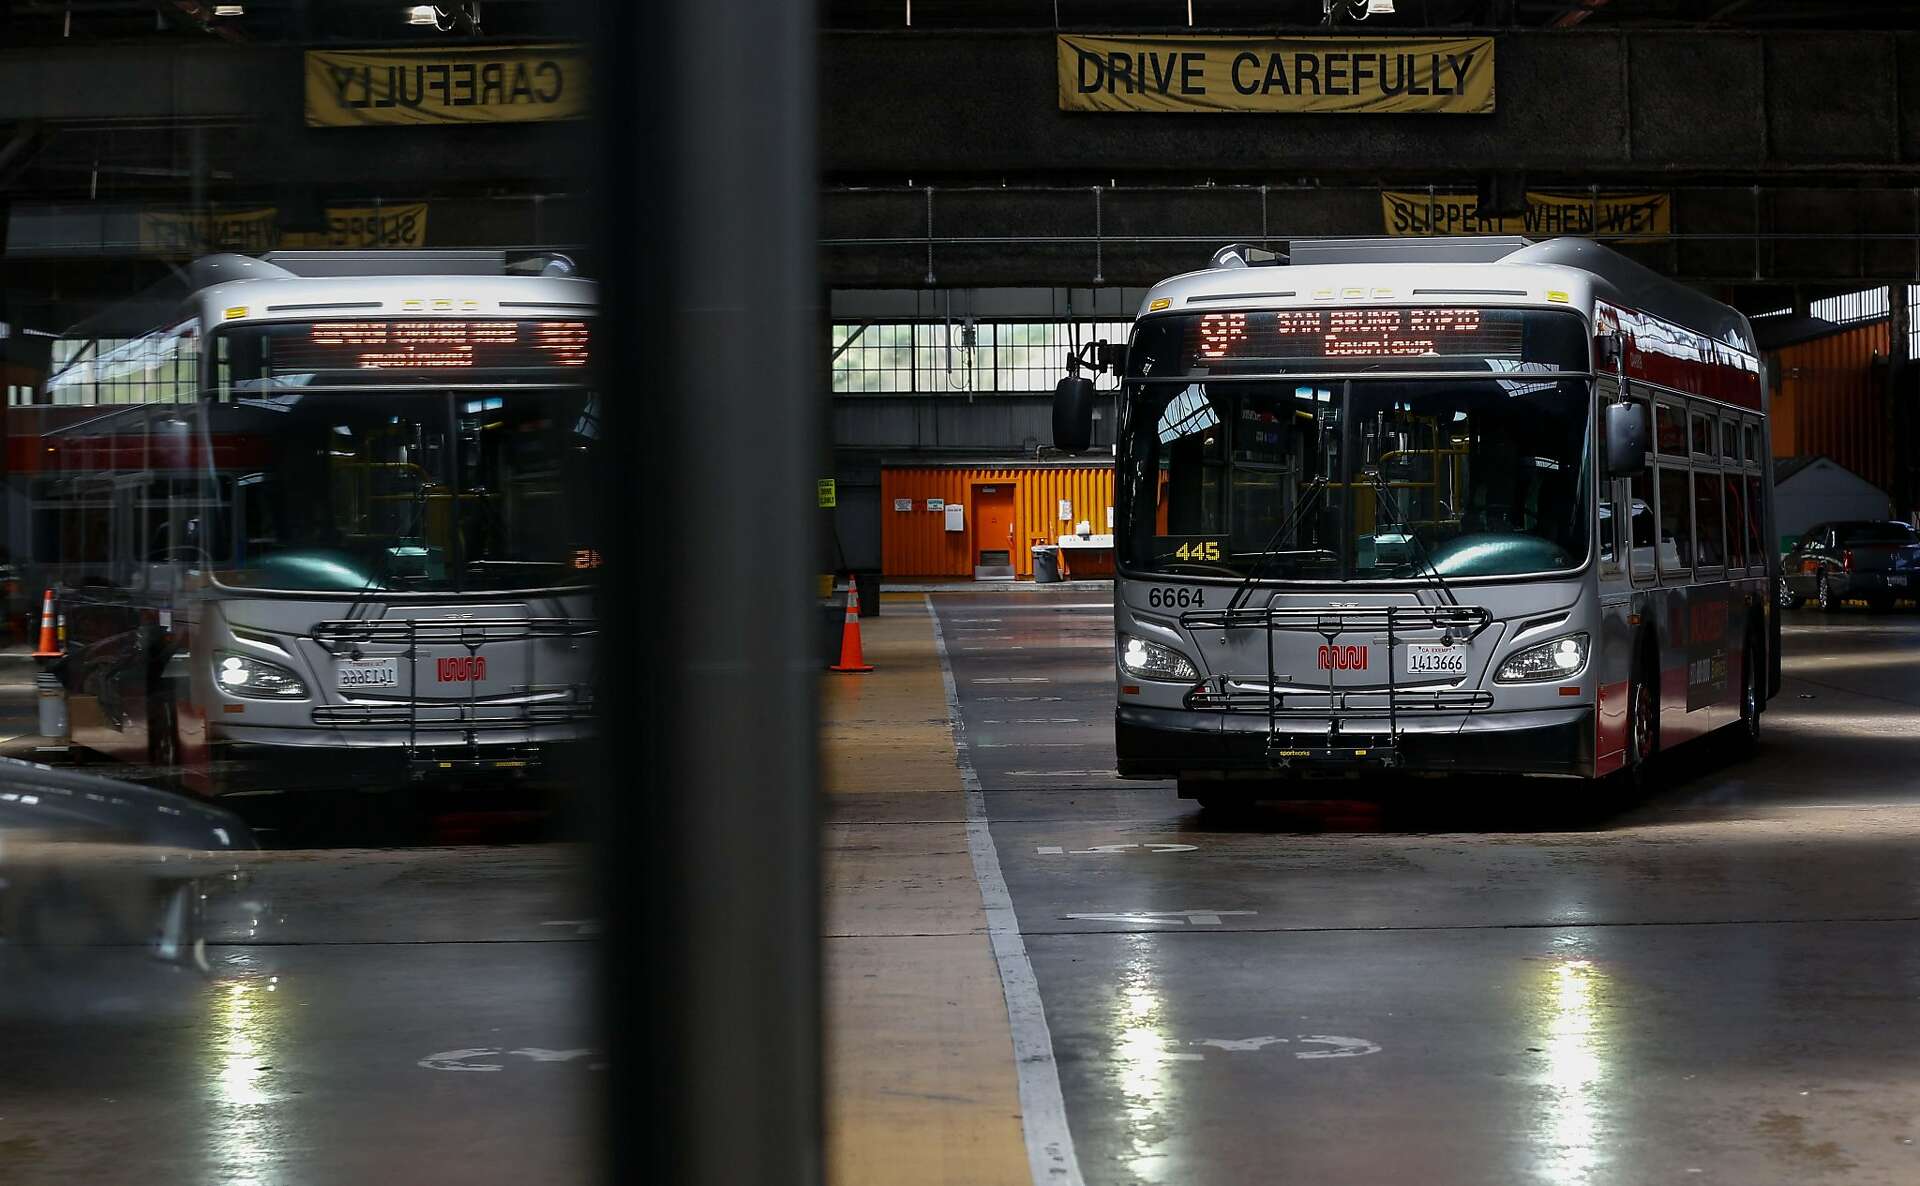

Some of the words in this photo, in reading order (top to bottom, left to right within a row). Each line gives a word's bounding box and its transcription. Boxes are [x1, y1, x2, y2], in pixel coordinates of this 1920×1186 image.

[1077, 51, 1206, 96] DRIVE
[1230, 51, 1475, 97] CAREFULLY
[1523, 203, 1593, 232] WHEN
[1606, 203, 1655, 232] WET
[1175, 541, 1220, 561] 445
[1149, 587, 1205, 608] 6664
[1411, 655, 1463, 670] 1413666
